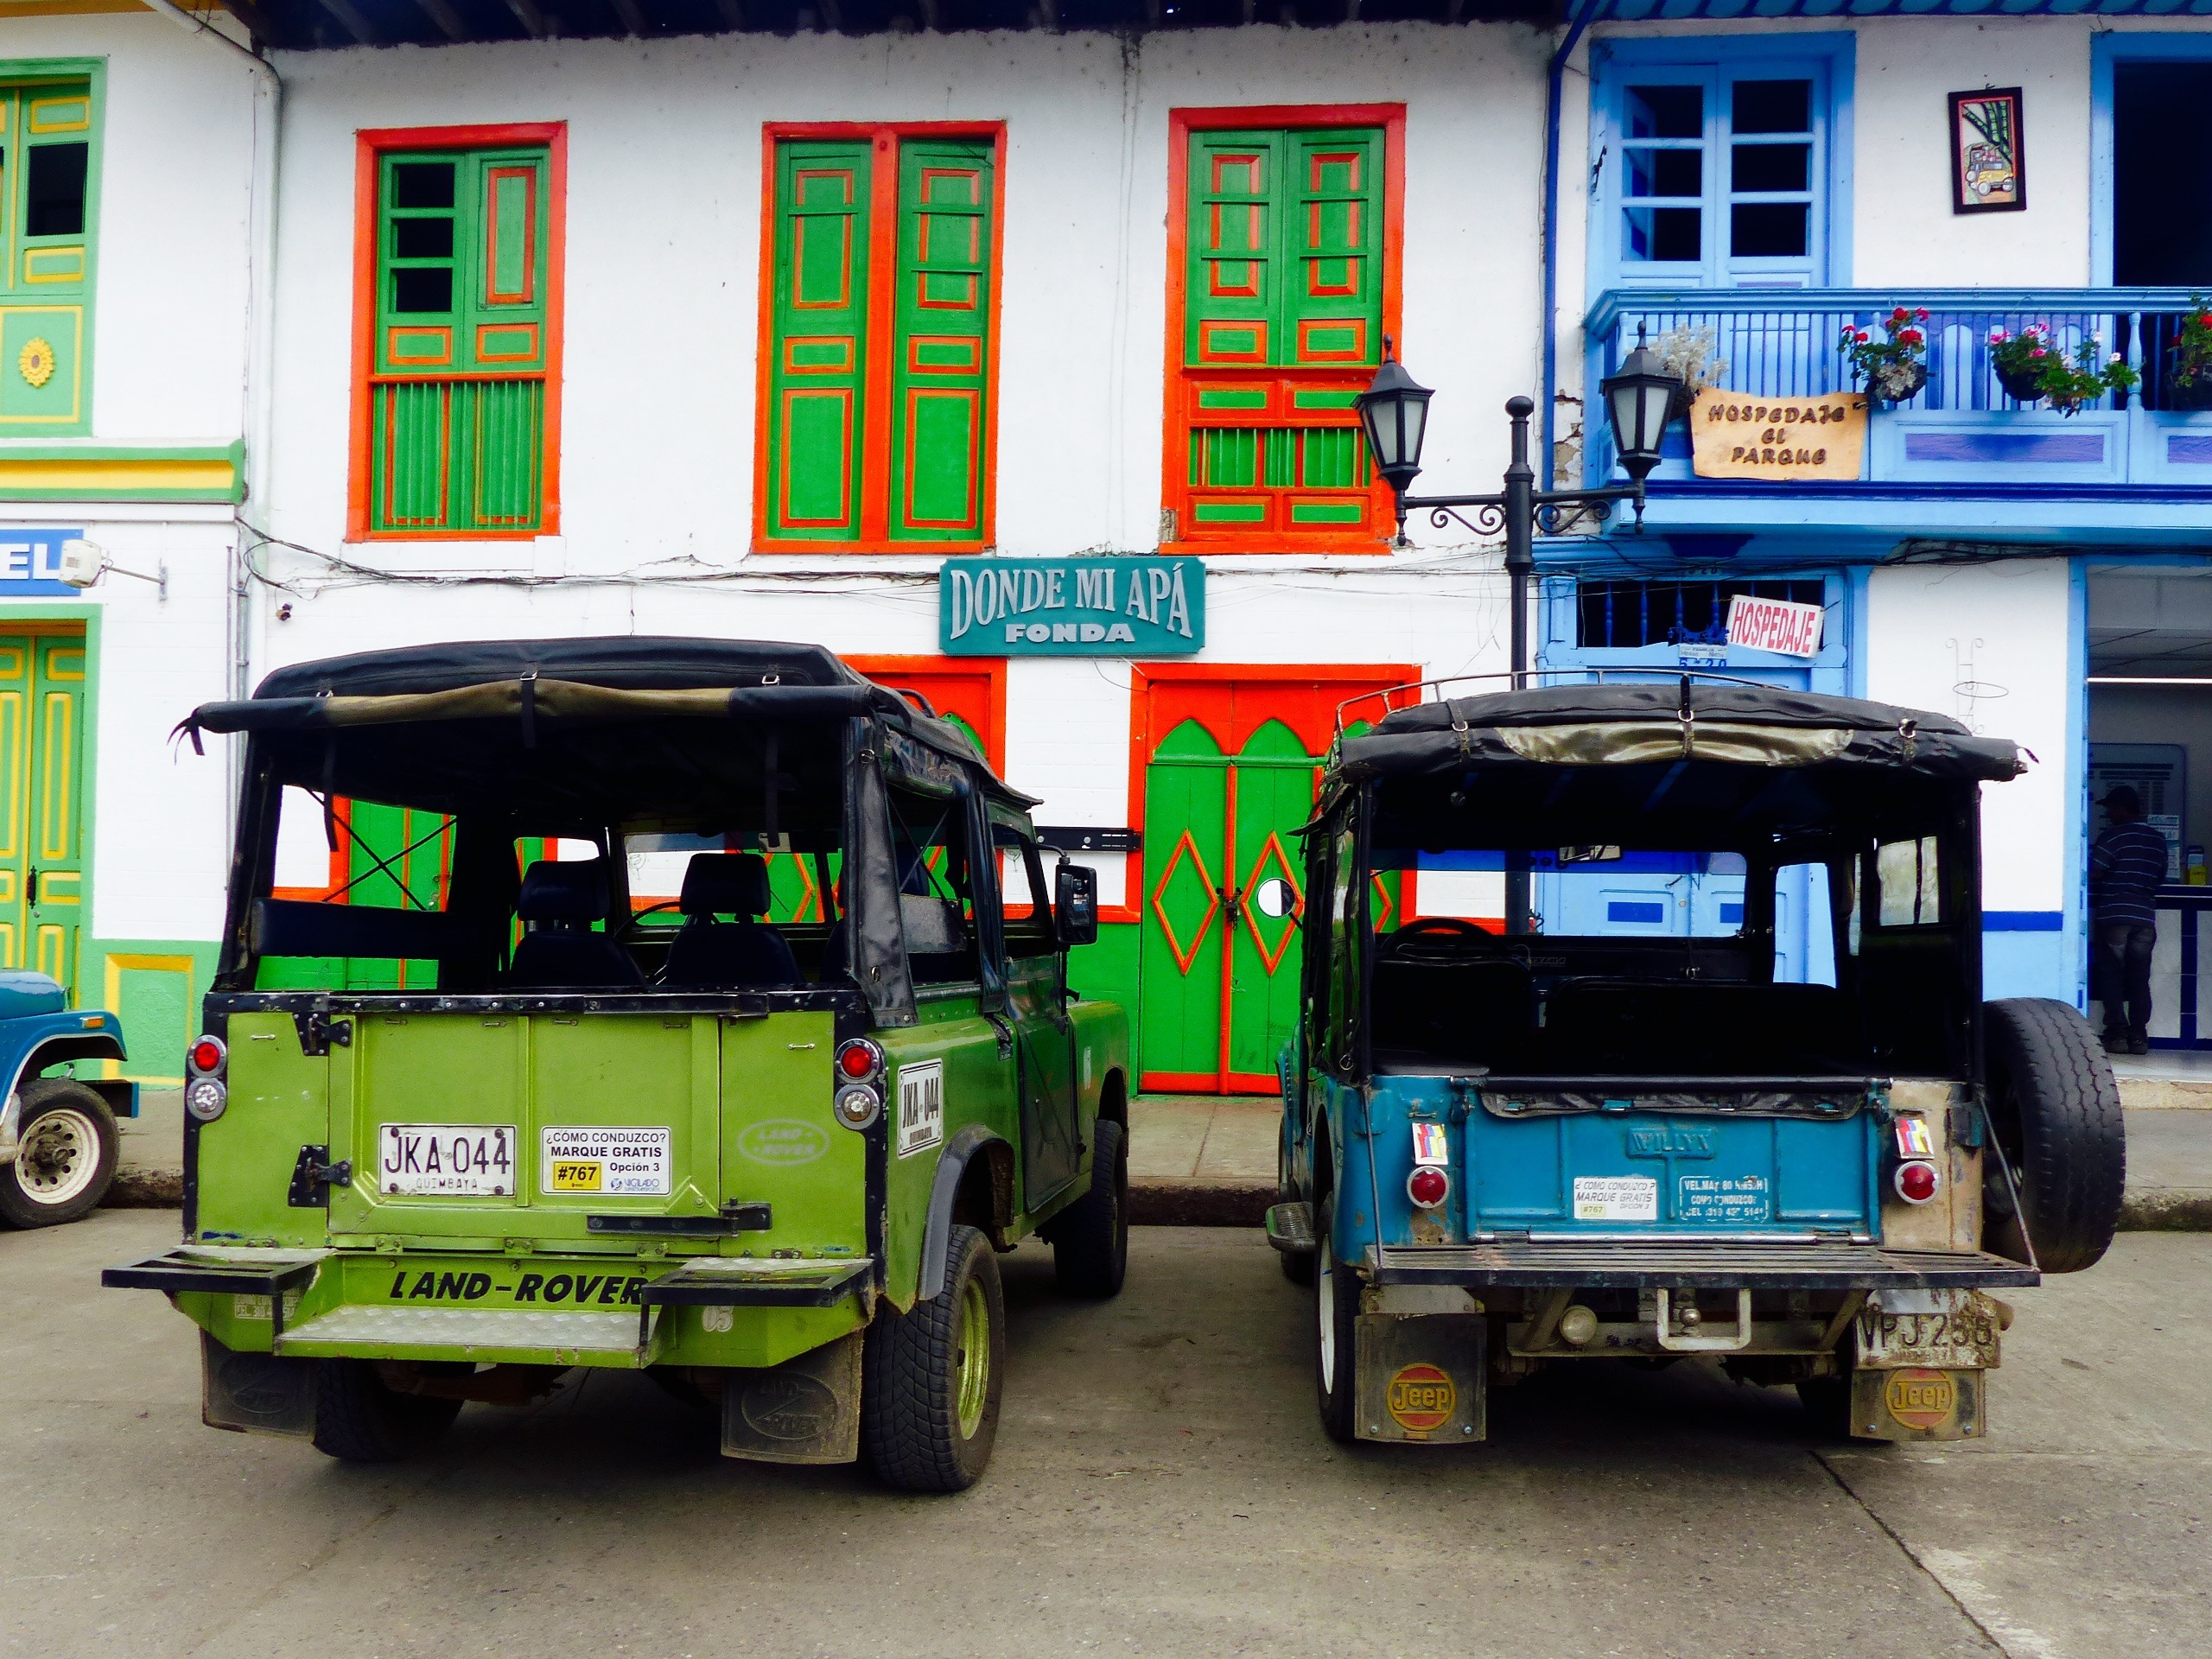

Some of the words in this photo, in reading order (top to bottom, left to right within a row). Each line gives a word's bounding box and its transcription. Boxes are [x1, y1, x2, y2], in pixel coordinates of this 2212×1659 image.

[1708, 404, 1846, 424] HOSPEDAJE
[1762, 428, 1787, 444] EL
[1731, 447, 1827, 465] PARQUE
[950, 568, 1065, 640] DONDE
[1075, 568, 1116, 612] MI
[1124, 562, 1193, 639] APÁ
[1005, 623, 1135, 643] FONDA
[1730, 601, 1816, 654] HOSPEDAJE
[902, 1081, 918, 1129] JKA
[924, 1077, 939, 1122] 044
[546, 1129, 588, 1144] ¿CÓMO
[592, 1132, 666, 1143] CONDUZCO?
[385, 1136, 442, 1174] JKA
[453, 1136, 511, 1174] 044
[550, 1147, 607, 1158] MARQUE
[613, 1147, 662, 1158] GRATIS
[557, 1166, 597, 1181] #767
[610, 1162, 649, 1173] Opción
[653, 1163, 660, 1172] 3
[416, 1178, 478, 1190] QUIMBAYA
[1722, 1180, 1733, 1191] 80
[1575, 1192, 1617, 1202] MARQUE
[1619, 1192, 1653, 1203] GRATIS
[702, 1306, 734, 1333] 05
[1393, 1383, 1450, 1411] Jeep
[1892, 1382, 1951, 1410] Jeep
